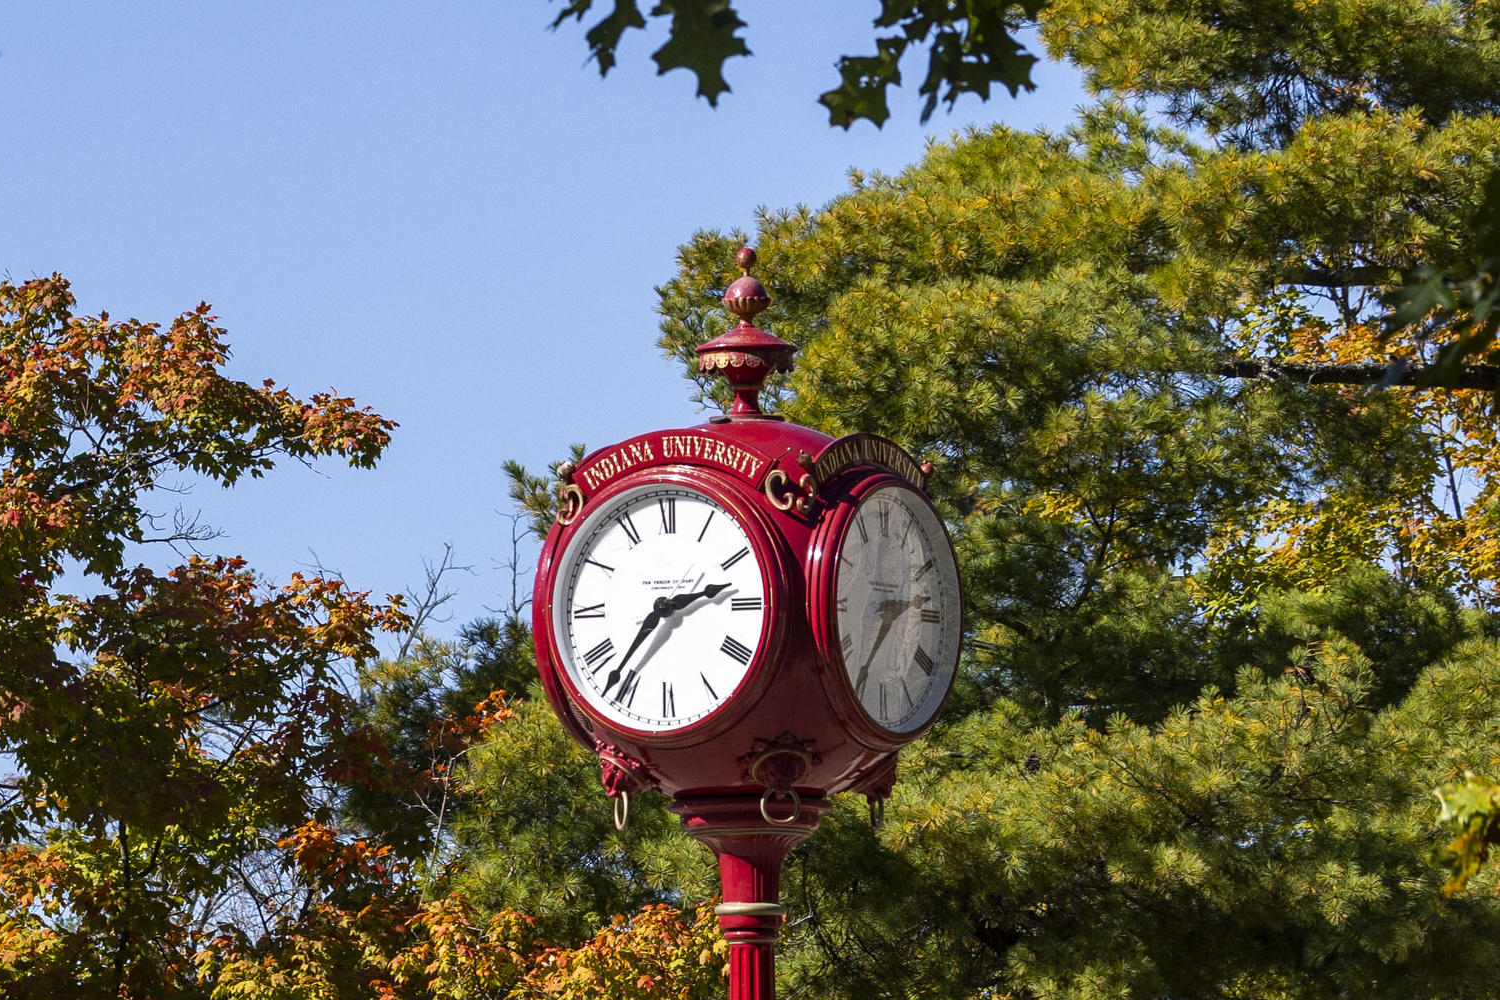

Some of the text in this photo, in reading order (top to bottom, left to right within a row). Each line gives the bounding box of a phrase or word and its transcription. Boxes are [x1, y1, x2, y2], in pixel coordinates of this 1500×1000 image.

[583, 436, 764, 491] INDIANA UNIVERSITY
[817, 439, 924, 489] INDIANA UNIVERSITY
